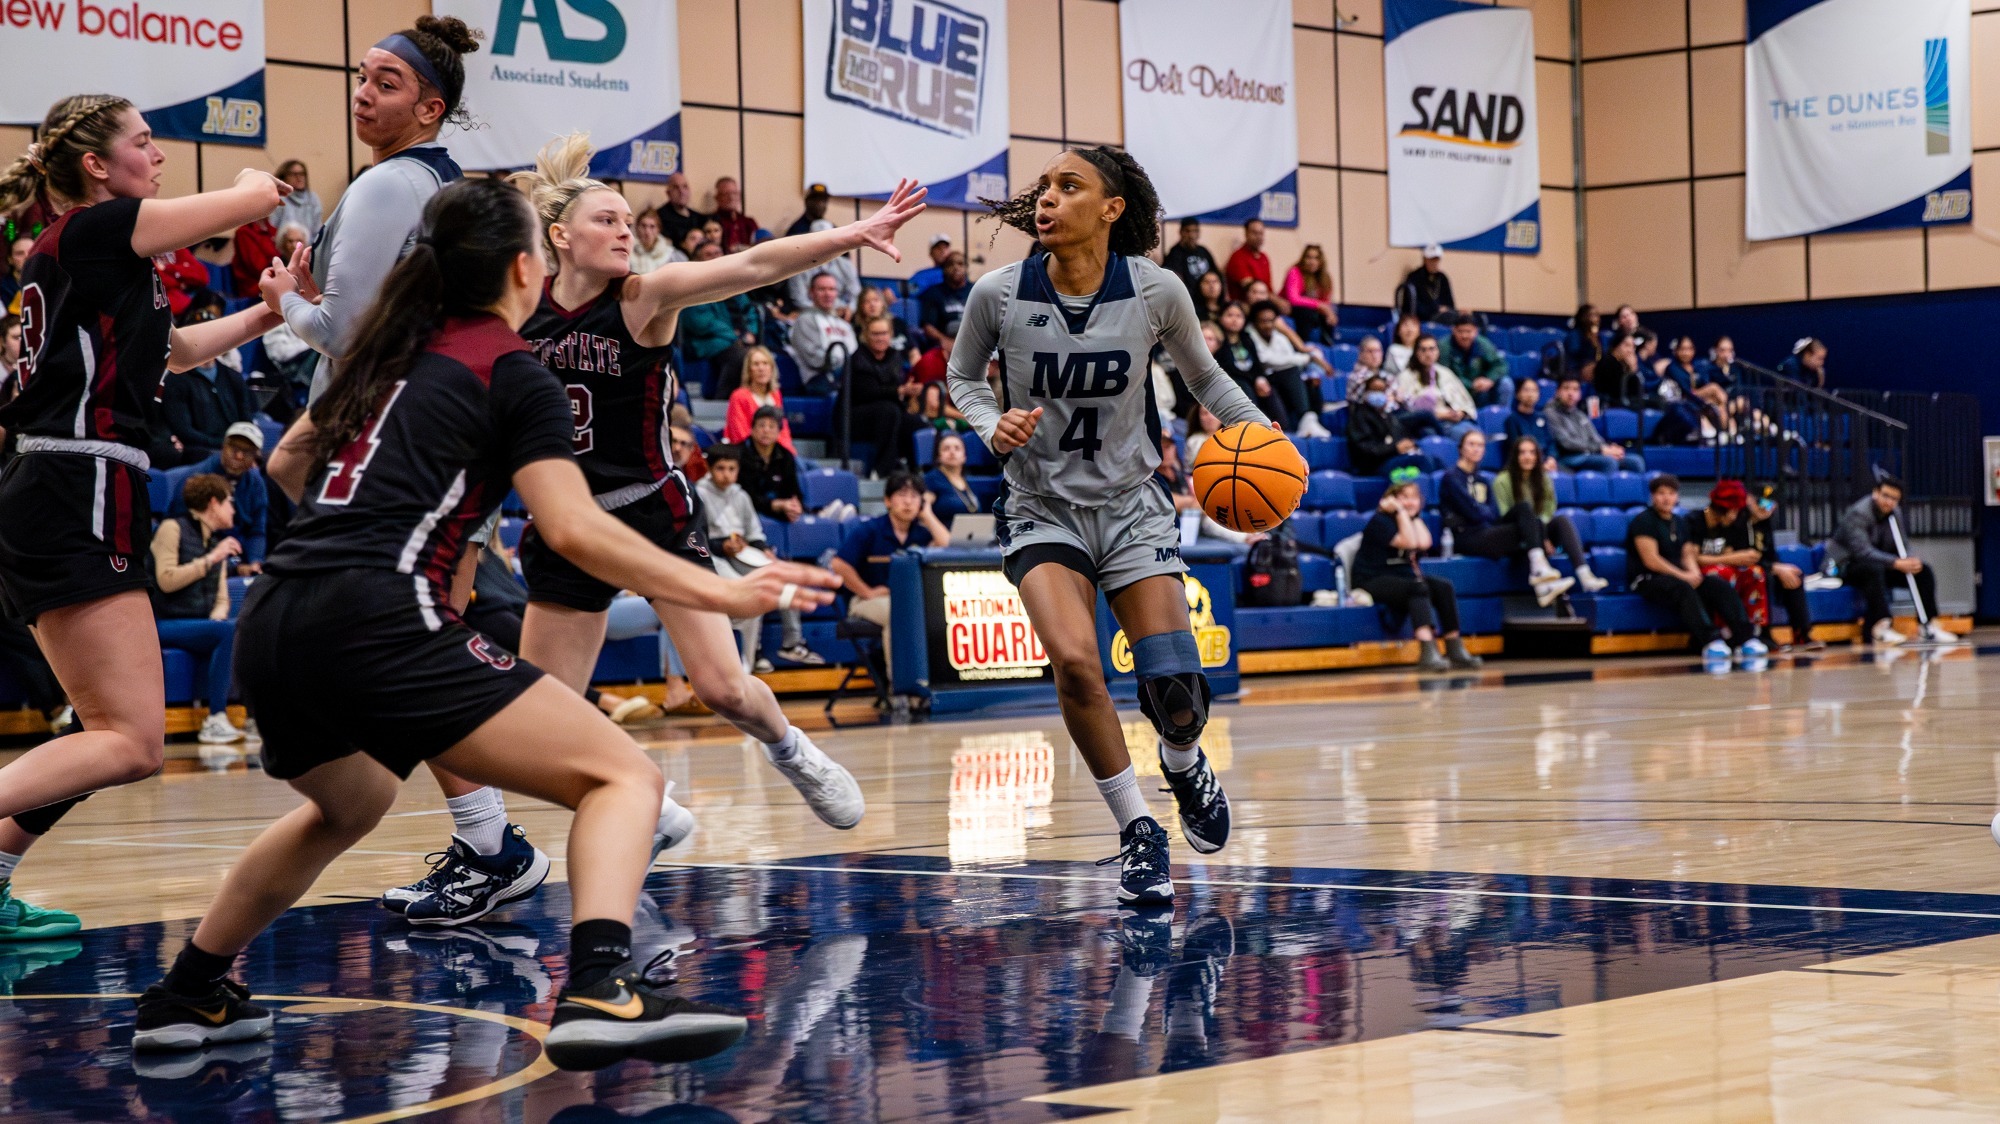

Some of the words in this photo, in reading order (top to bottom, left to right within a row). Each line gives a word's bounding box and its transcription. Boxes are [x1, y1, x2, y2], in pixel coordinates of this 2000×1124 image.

[0, 0, 65, 31] ew
[78, 0, 243, 51] balance
[490, 0, 628, 64] AS
[841, 0, 981, 77] BLUE
[491, 64, 565, 87] Associated
[568, 71, 629, 92] Students
[1127, 58, 1184, 96] Deli
[1188, 64, 1285, 105] Delicious
[202, 97, 262, 136] MB
[1401, 86, 1524, 144] SAND
[1769, 96, 1819, 121] THE
[1828, 87, 1920, 116] DUNES
[554, 331, 621, 376] STATE
[1029, 350, 1131, 399] MB
[1059, 407, 1102, 461] 4
[949, 598, 1022, 618] NATIONAL
[952, 622, 1047, 665] GUARD
